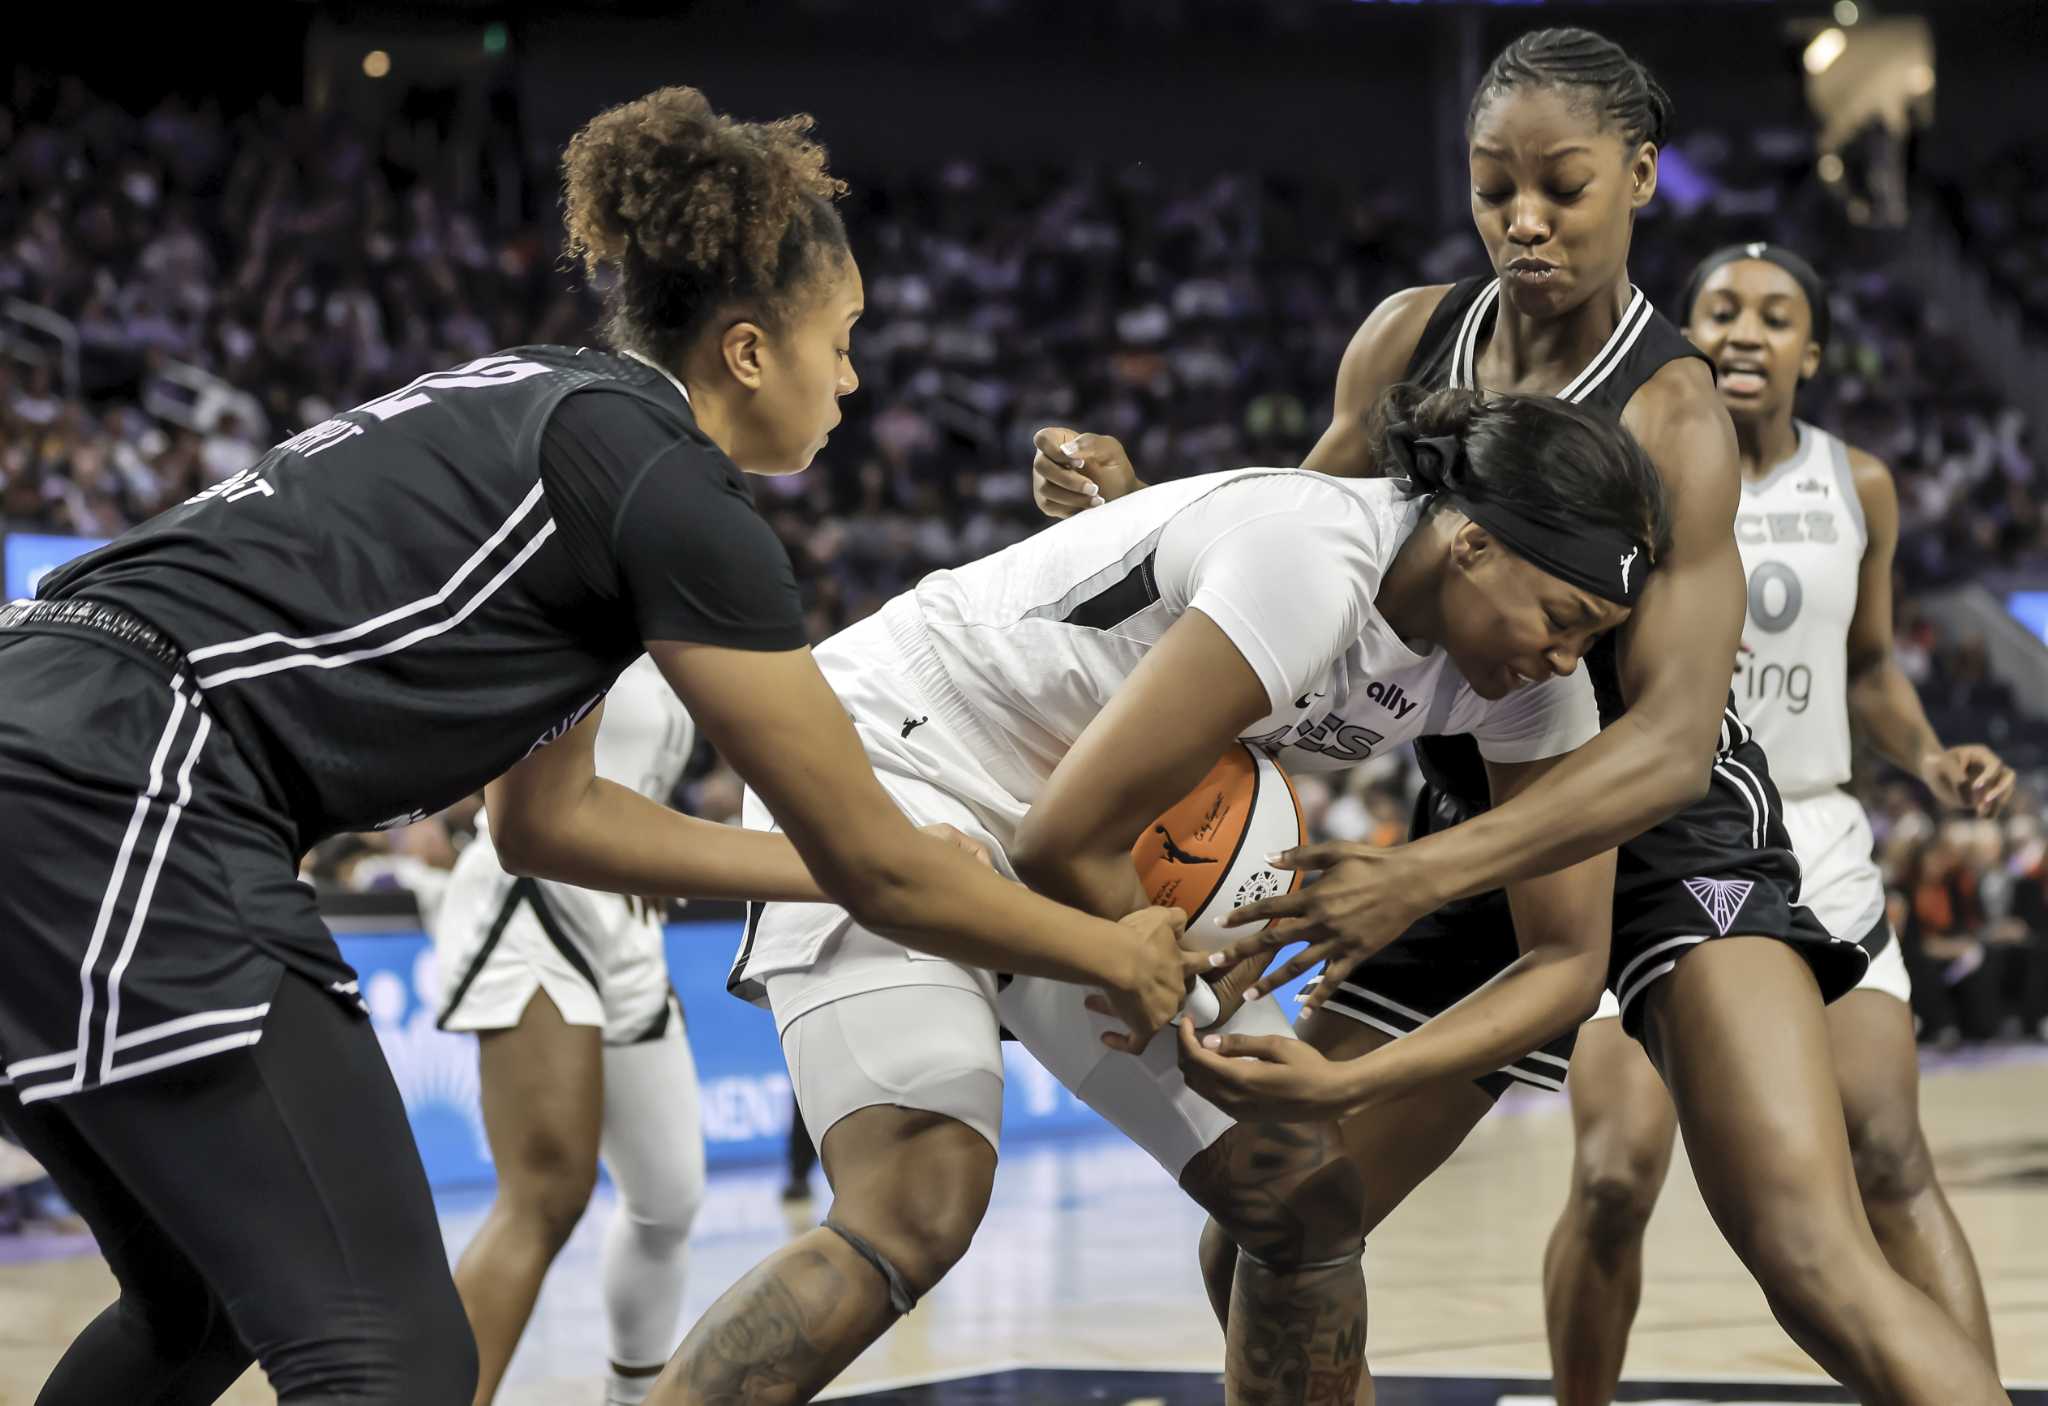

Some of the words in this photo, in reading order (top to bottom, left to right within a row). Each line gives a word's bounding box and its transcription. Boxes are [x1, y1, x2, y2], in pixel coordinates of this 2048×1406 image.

[1748, 560, 1803, 635] 0
[1366, 681, 1417, 720] ally
[1734, 651, 1812, 714] ing
